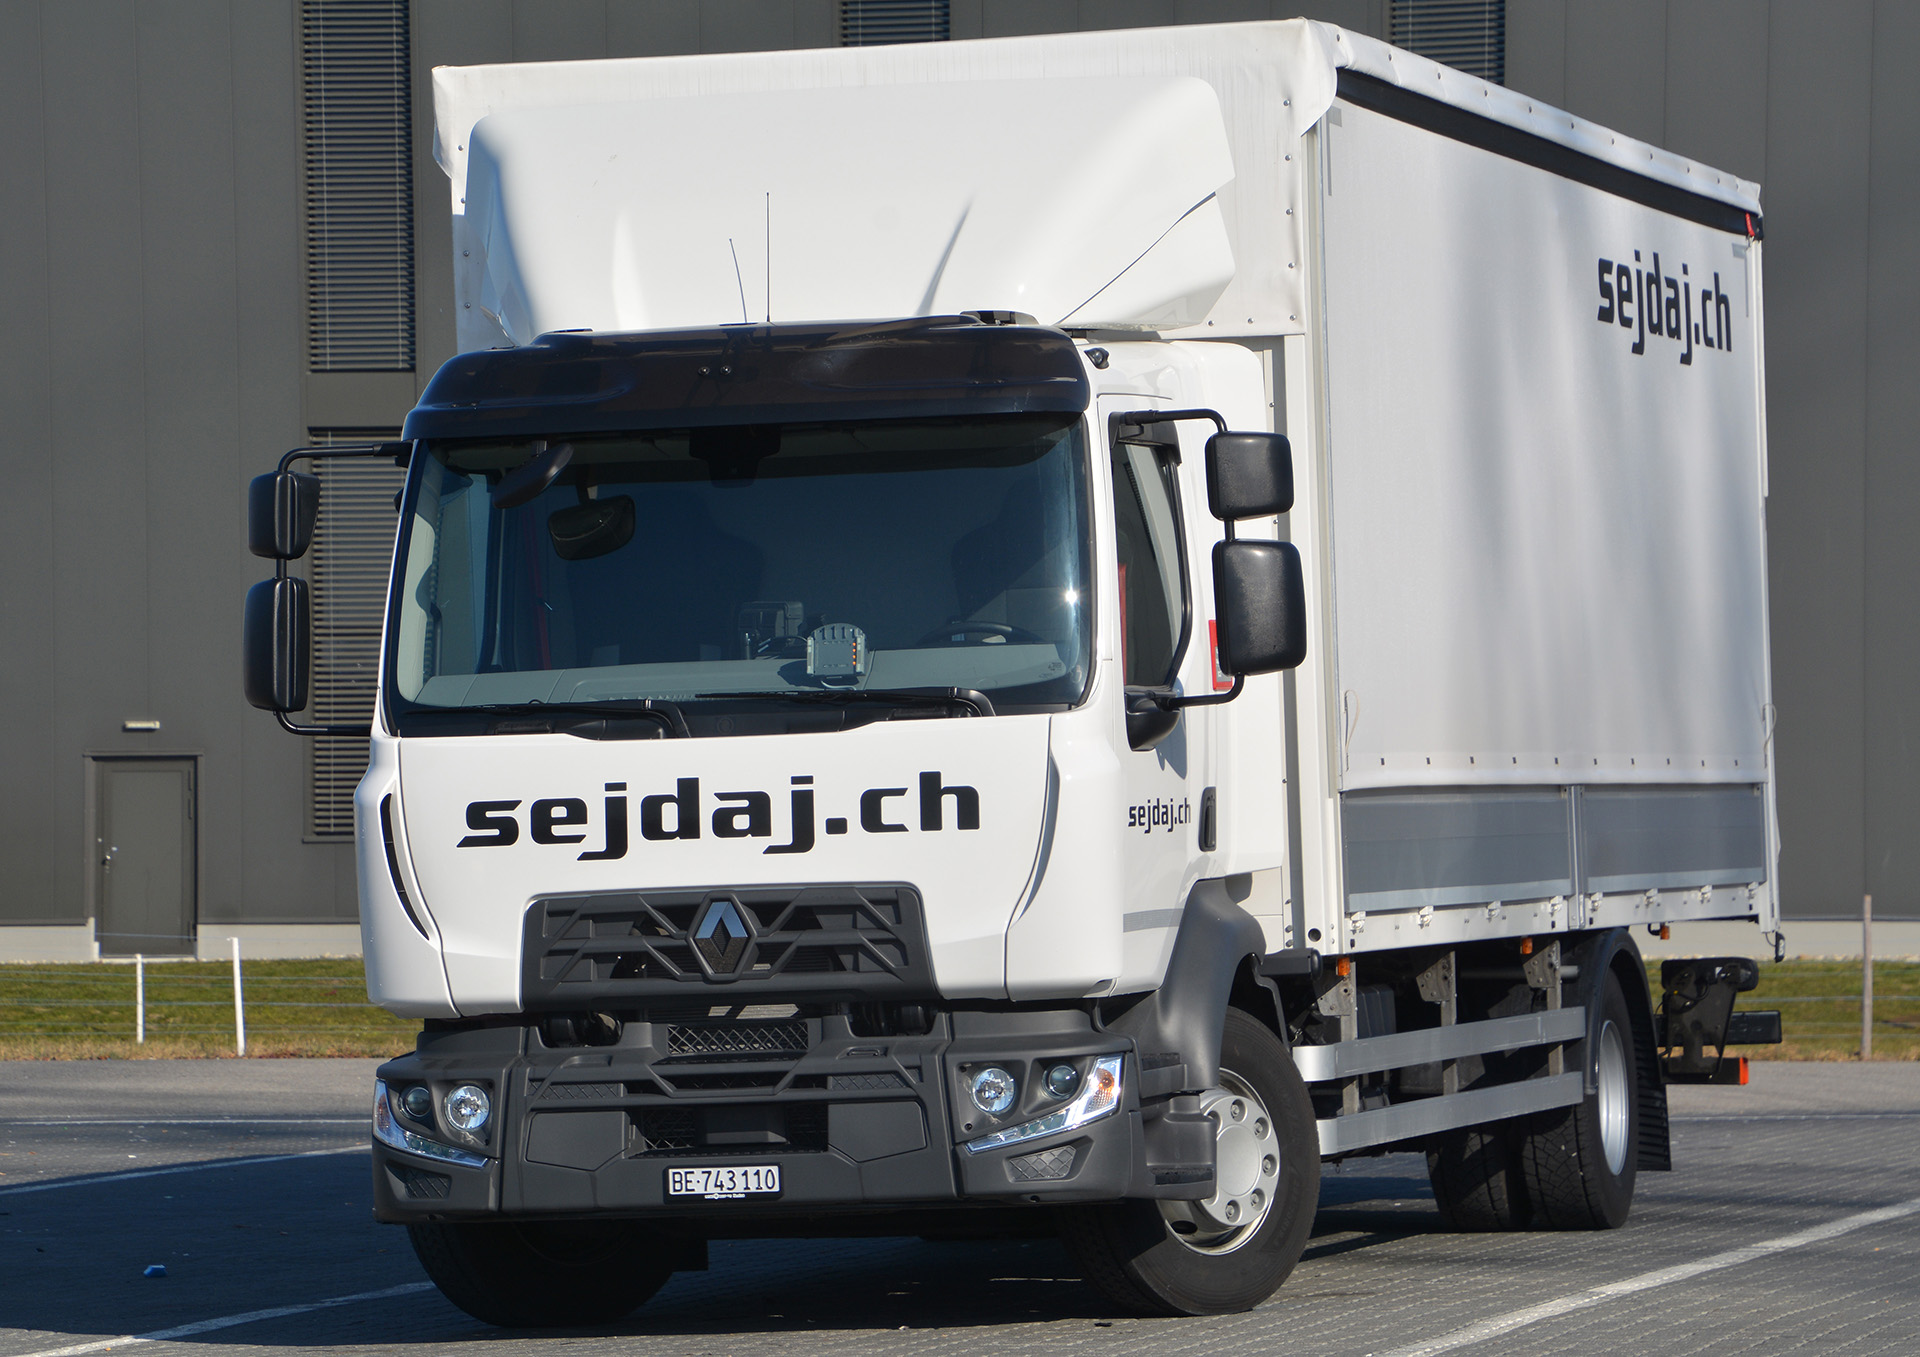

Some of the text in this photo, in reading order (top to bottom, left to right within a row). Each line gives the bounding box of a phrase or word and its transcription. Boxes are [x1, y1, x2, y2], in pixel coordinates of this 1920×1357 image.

[1597, 249, 1732, 366] sejdaj.ch
[457, 771, 980, 861] sejdaj.ch
[1127, 797, 1191, 834] sejdaj.ch
